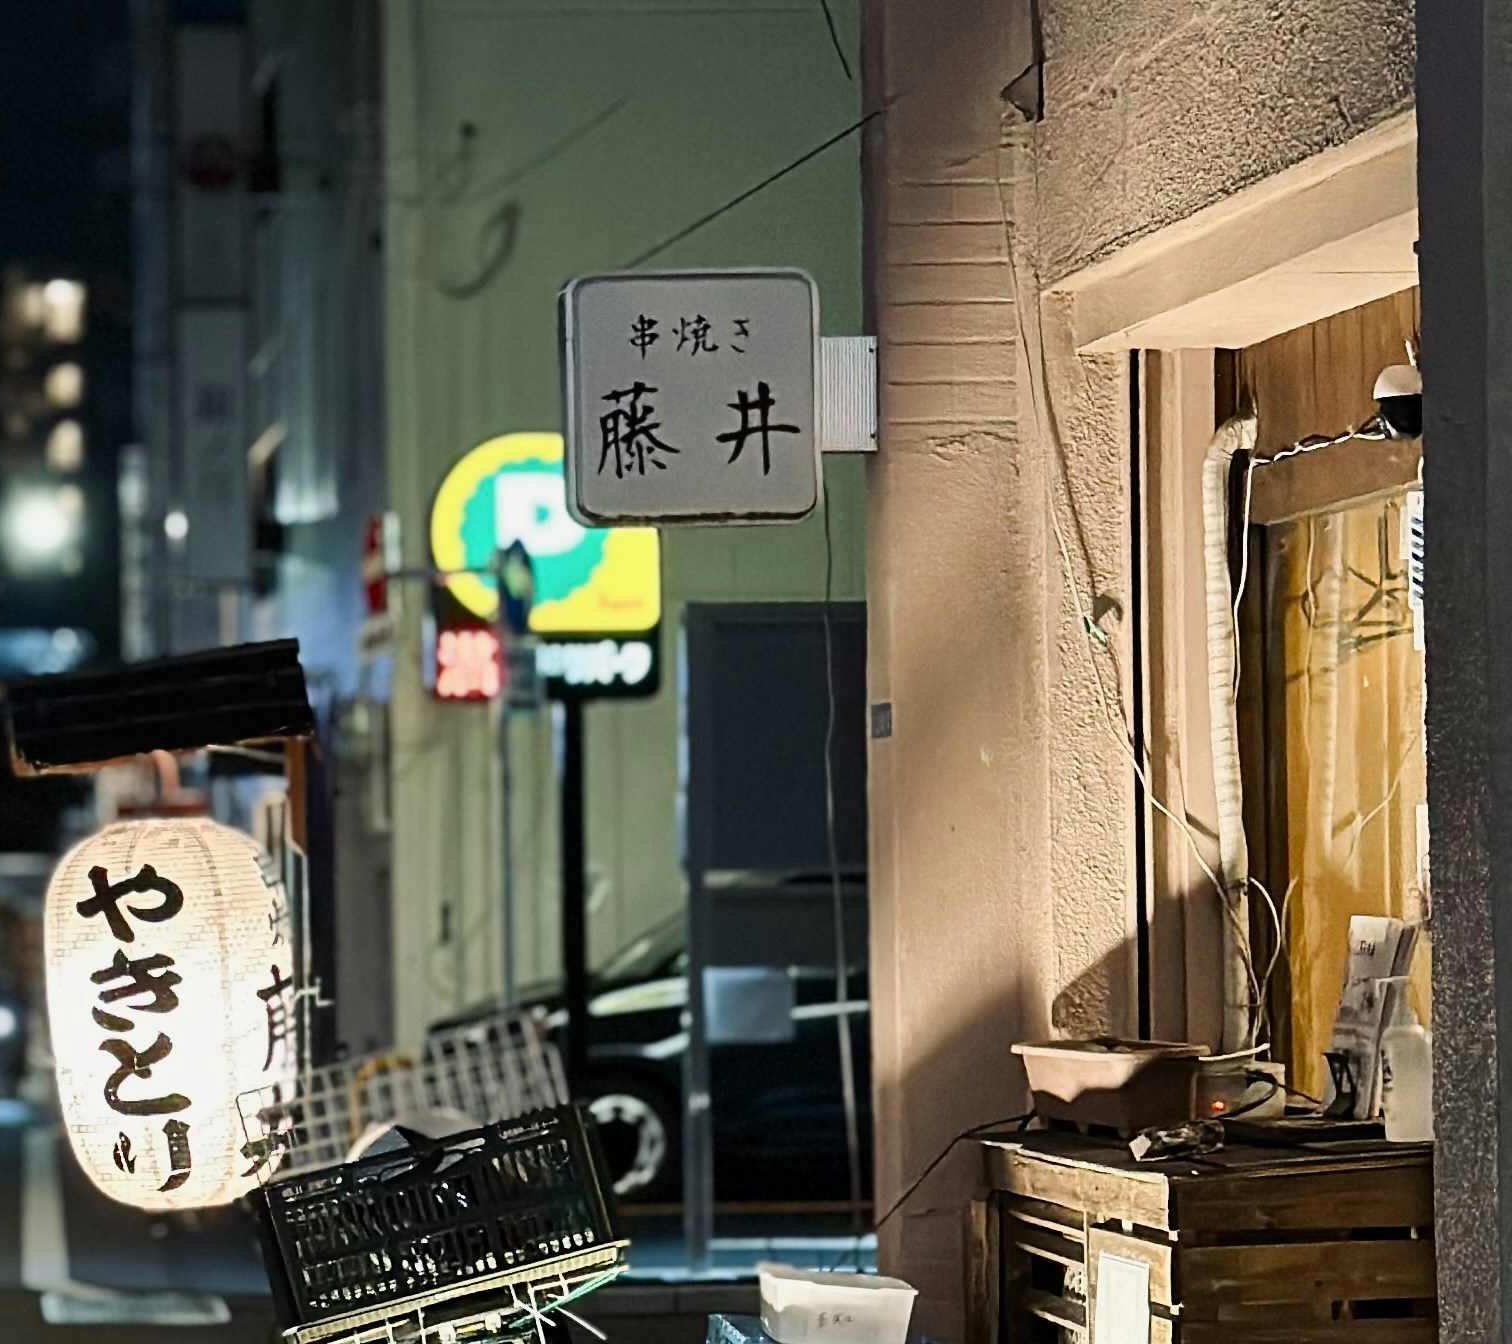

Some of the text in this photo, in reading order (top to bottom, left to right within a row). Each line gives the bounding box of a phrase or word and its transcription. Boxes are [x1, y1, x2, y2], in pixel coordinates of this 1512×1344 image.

[628, 314, 751, 360] 串焼き
[598, 381, 801, 479] 藤井
[76, 863, 192, 1192] やきとり
